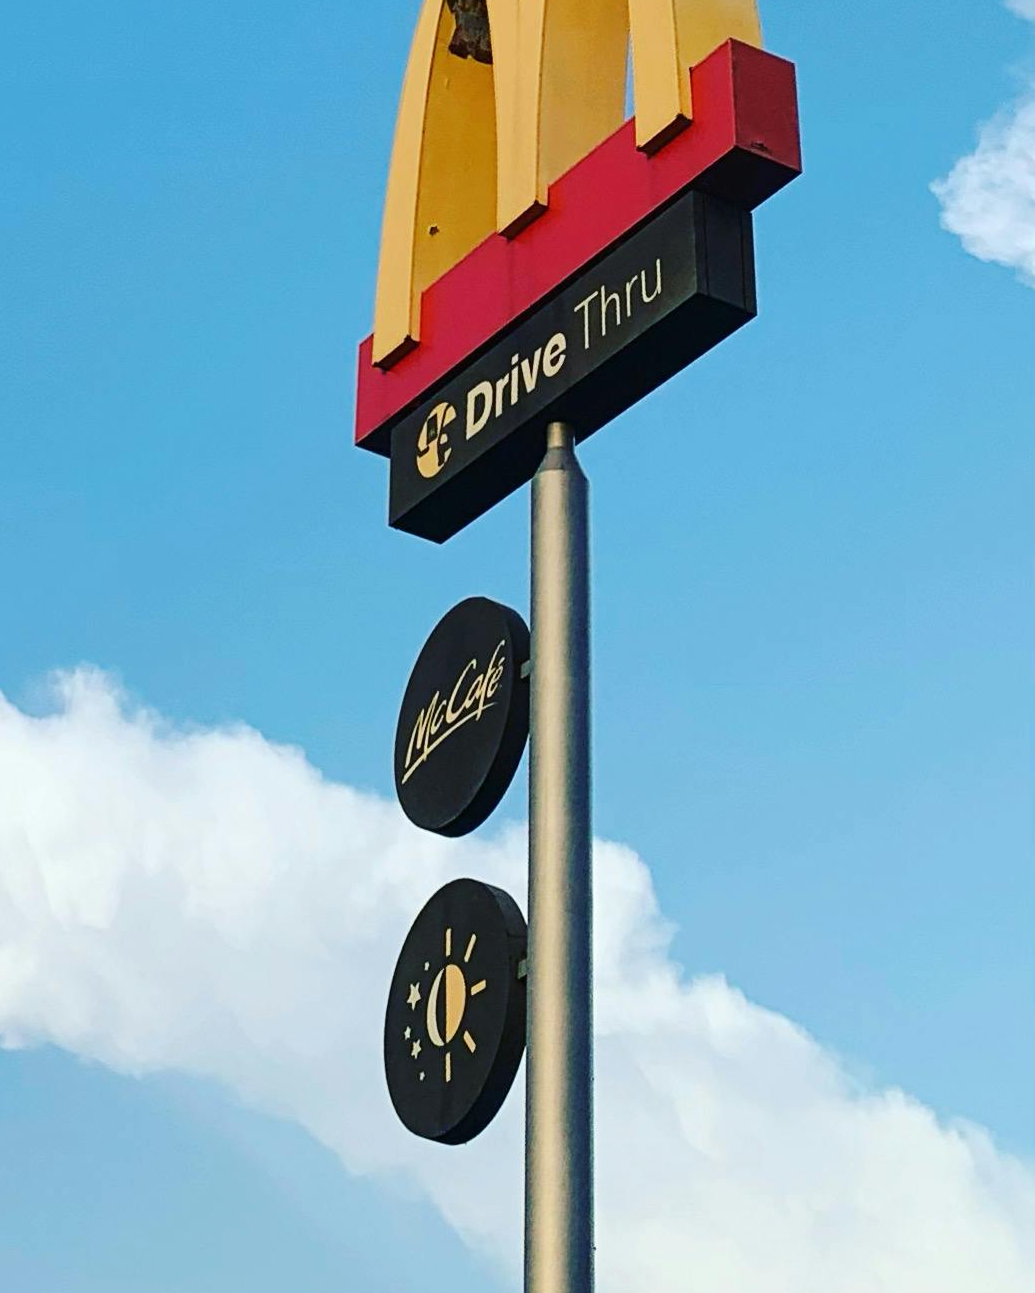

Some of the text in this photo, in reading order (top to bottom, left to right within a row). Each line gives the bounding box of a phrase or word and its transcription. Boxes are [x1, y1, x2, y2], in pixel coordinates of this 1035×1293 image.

[465, 258, 663, 441] Drive Thru
[404, 639, 505, 771] McCafé
